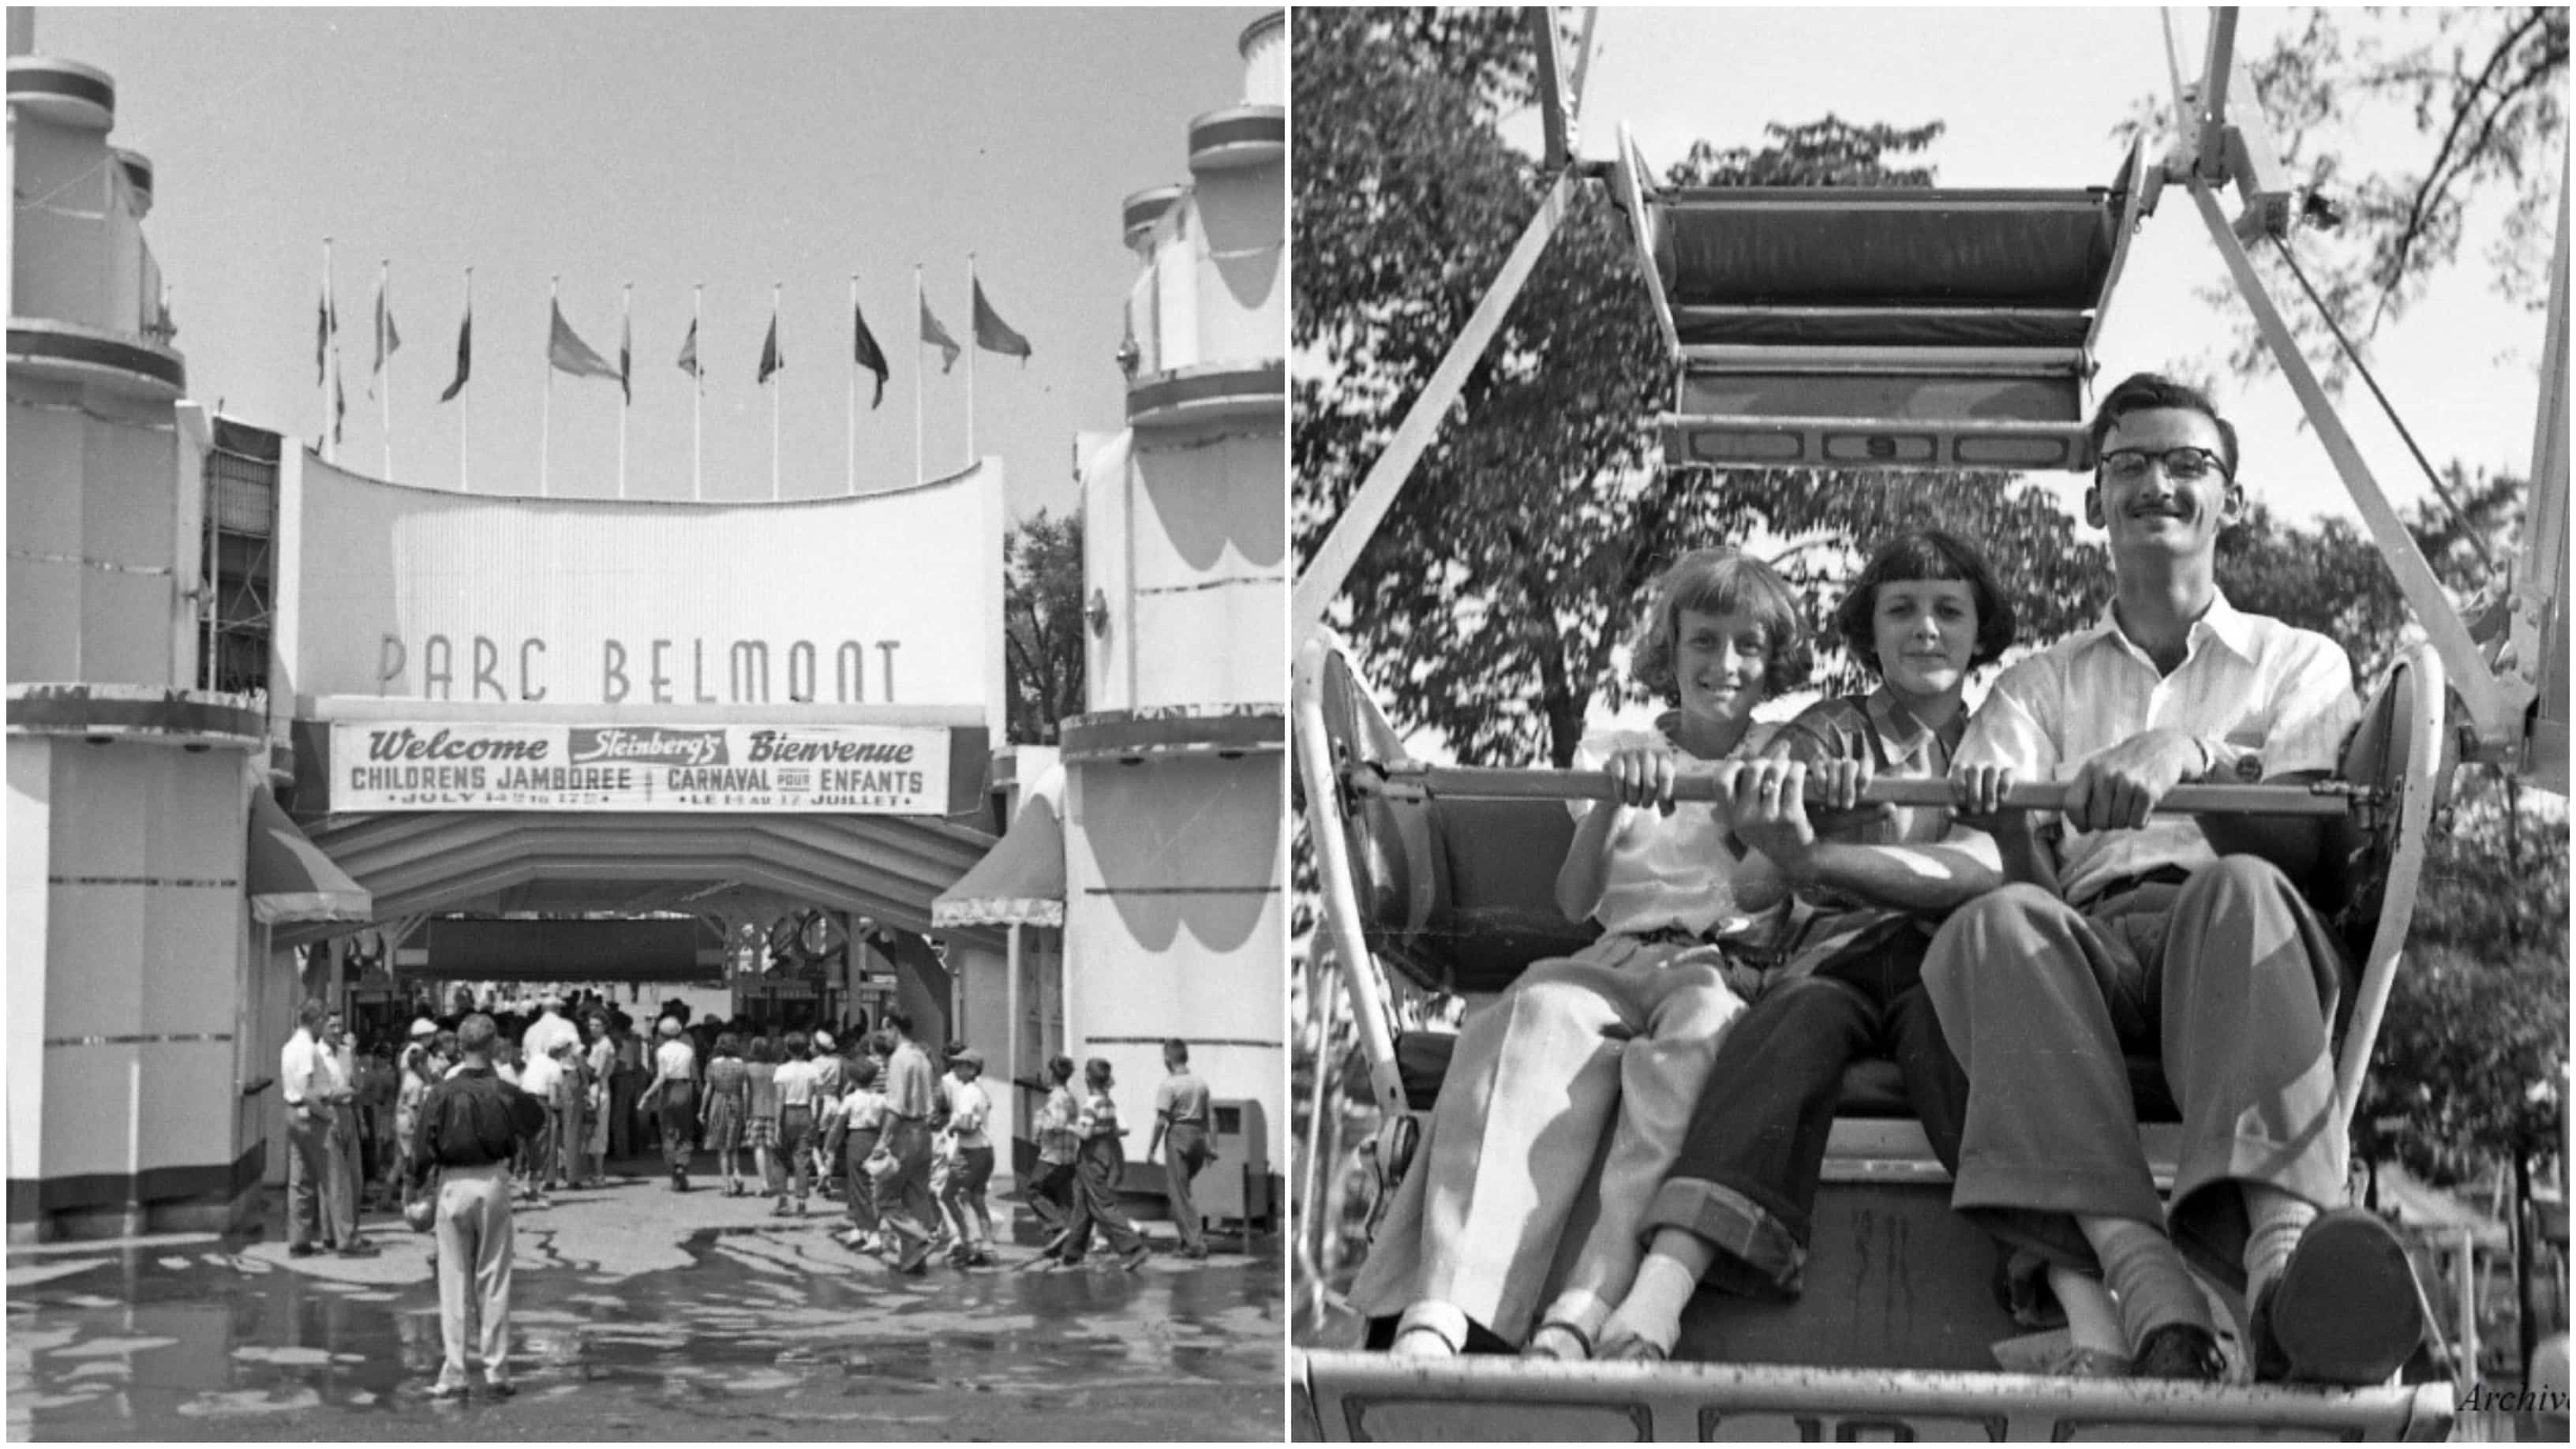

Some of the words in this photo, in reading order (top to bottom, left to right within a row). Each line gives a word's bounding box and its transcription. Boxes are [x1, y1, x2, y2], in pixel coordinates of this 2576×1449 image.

[1866, 435, 1896, 462] 9
[376, 634, 547, 702] PARC
[602, 637, 901, 703] BELMONT
[369, 728, 549, 762] Welcome
[573, 730, 722, 765] Steinberg's
[747, 730, 915, 764] Bienvenue
[351, 766, 486, 790] CHILDRENS
[496, 766, 632, 790] JAMBOREE
[668, 767, 771, 792] CARNAVAL
[820, 769, 923, 794] ENFANTS
[401, 792, 474, 803] JULY
[691, 794, 715, 805] LE
[810, 794, 899, 807] JUILLET
